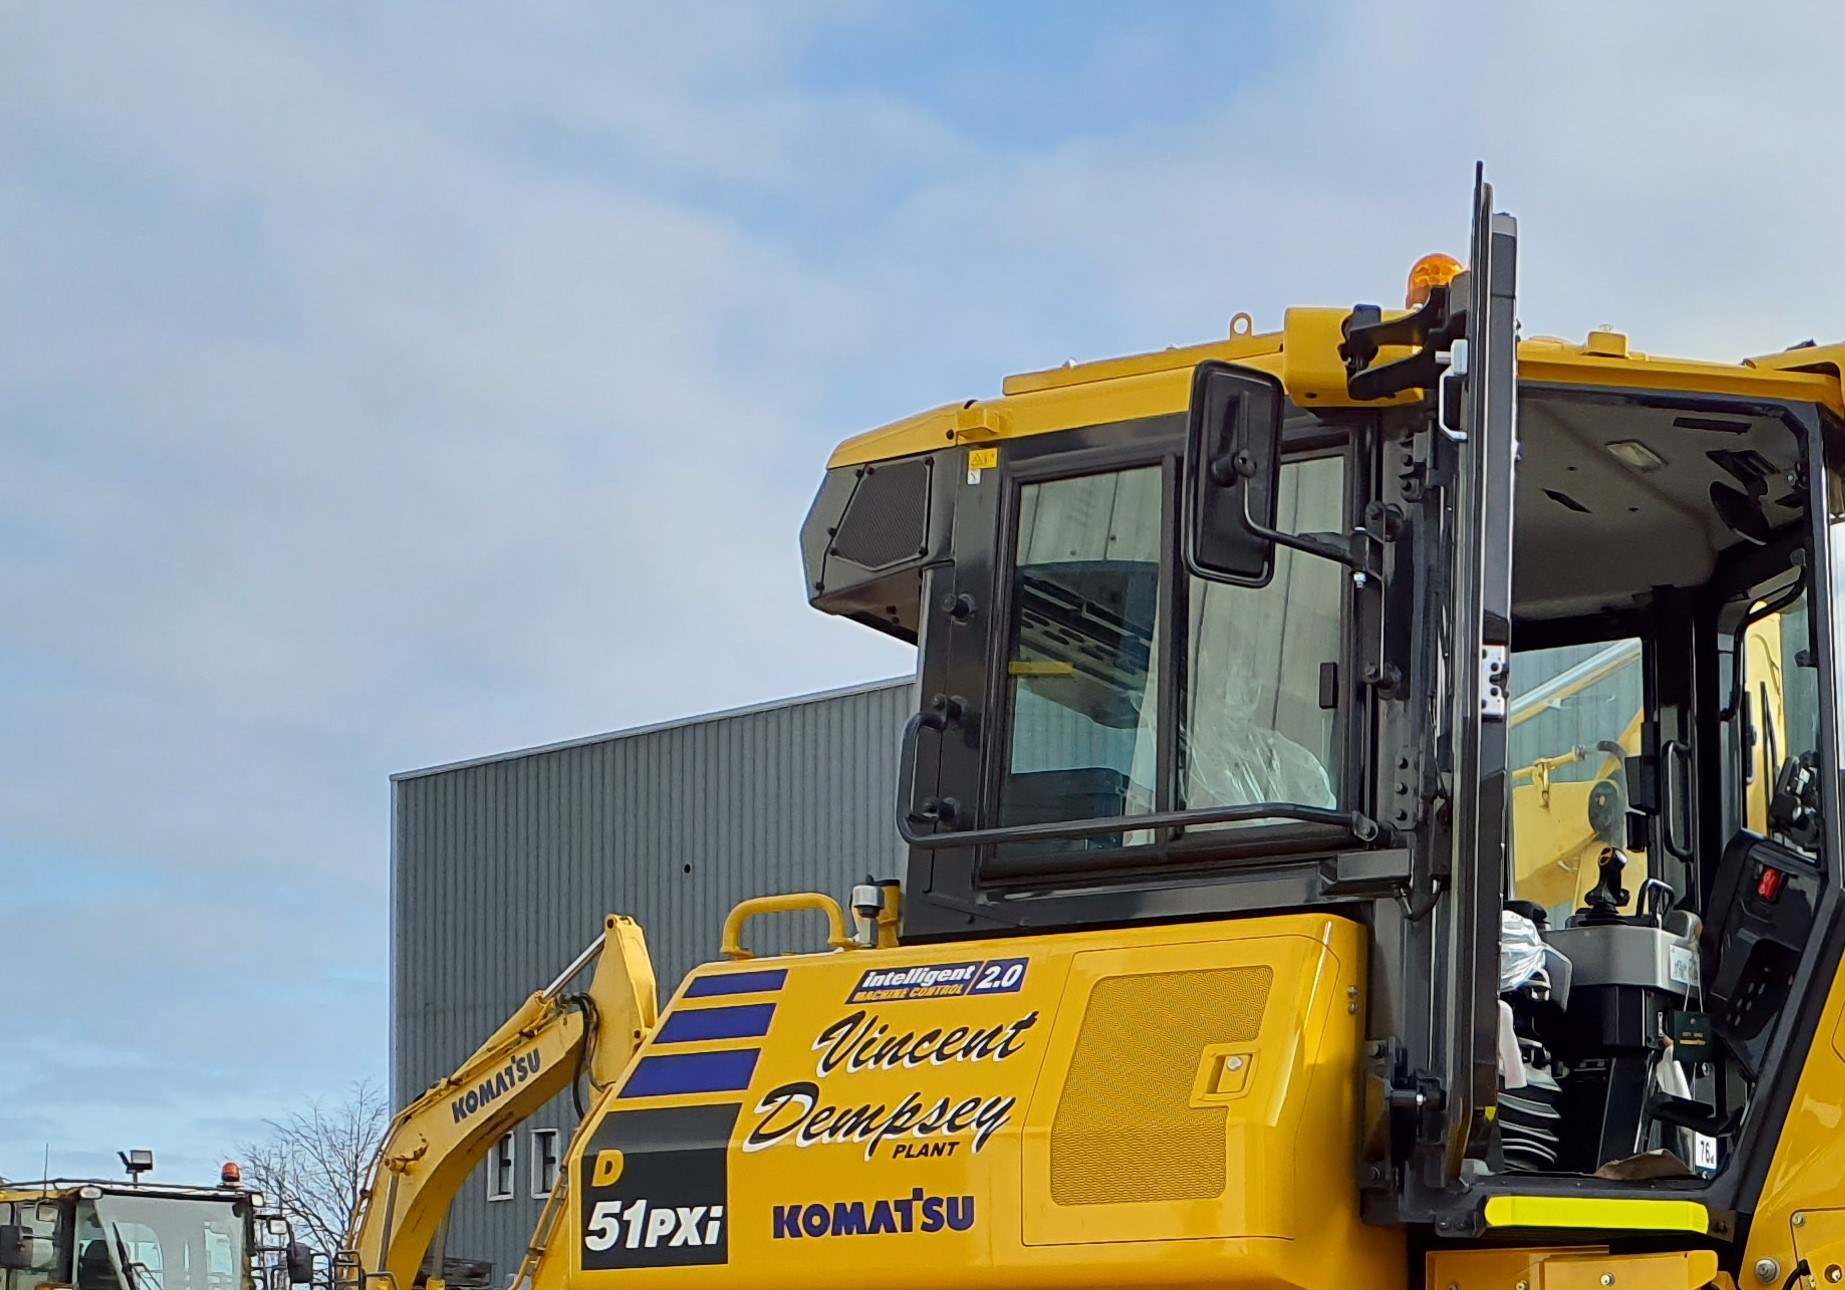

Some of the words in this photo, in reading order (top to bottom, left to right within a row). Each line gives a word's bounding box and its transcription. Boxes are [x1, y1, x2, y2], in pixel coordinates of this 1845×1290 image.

[852, 988, 908, 1002] MACHINE
[910, 983, 963, 998] CONTROL
[975, 963, 1024, 989] 2.0
[811, 1010, 1040, 1078] Vincent
[451, 1047, 541, 1125] KOMATSU
[742, 1081, 1017, 1162] Dempsey
[591, 1149, 625, 1188] D
[891, 1141, 961, 1160] PLANT
[584, 1199, 724, 1252] 51PXi
[772, 1187, 976, 1240] KOMATSU
